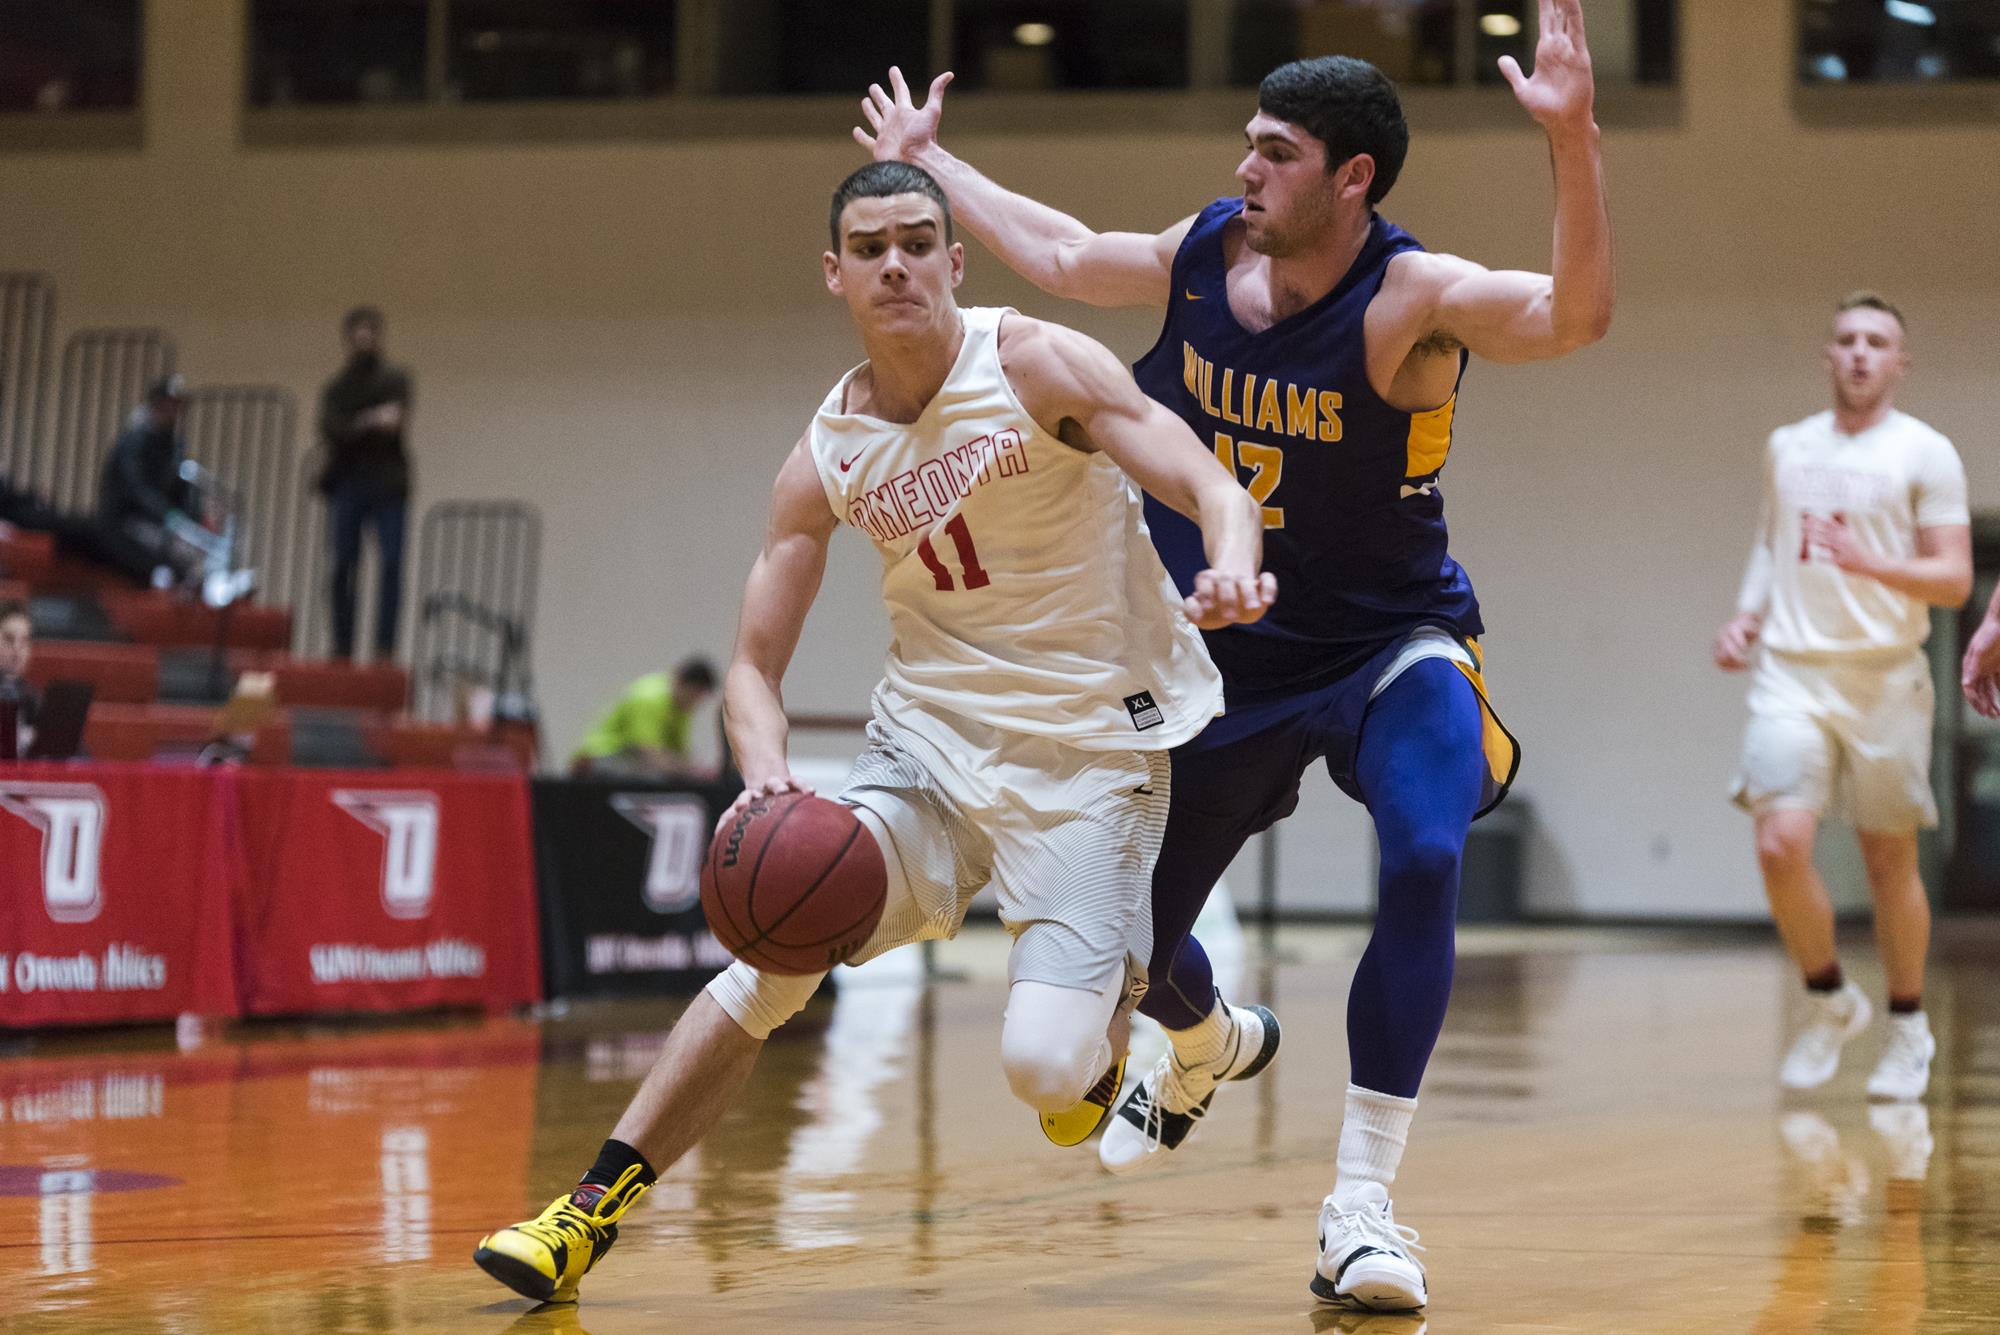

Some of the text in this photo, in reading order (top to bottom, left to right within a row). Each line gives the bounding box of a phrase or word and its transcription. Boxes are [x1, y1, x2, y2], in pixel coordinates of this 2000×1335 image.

[1183, 340, 1343, 442] WILLIAMS
[849, 428, 1029, 542] ONEONTA
[917, 512, 990, 591] 11
[1131, 696, 1150, 711] XL
